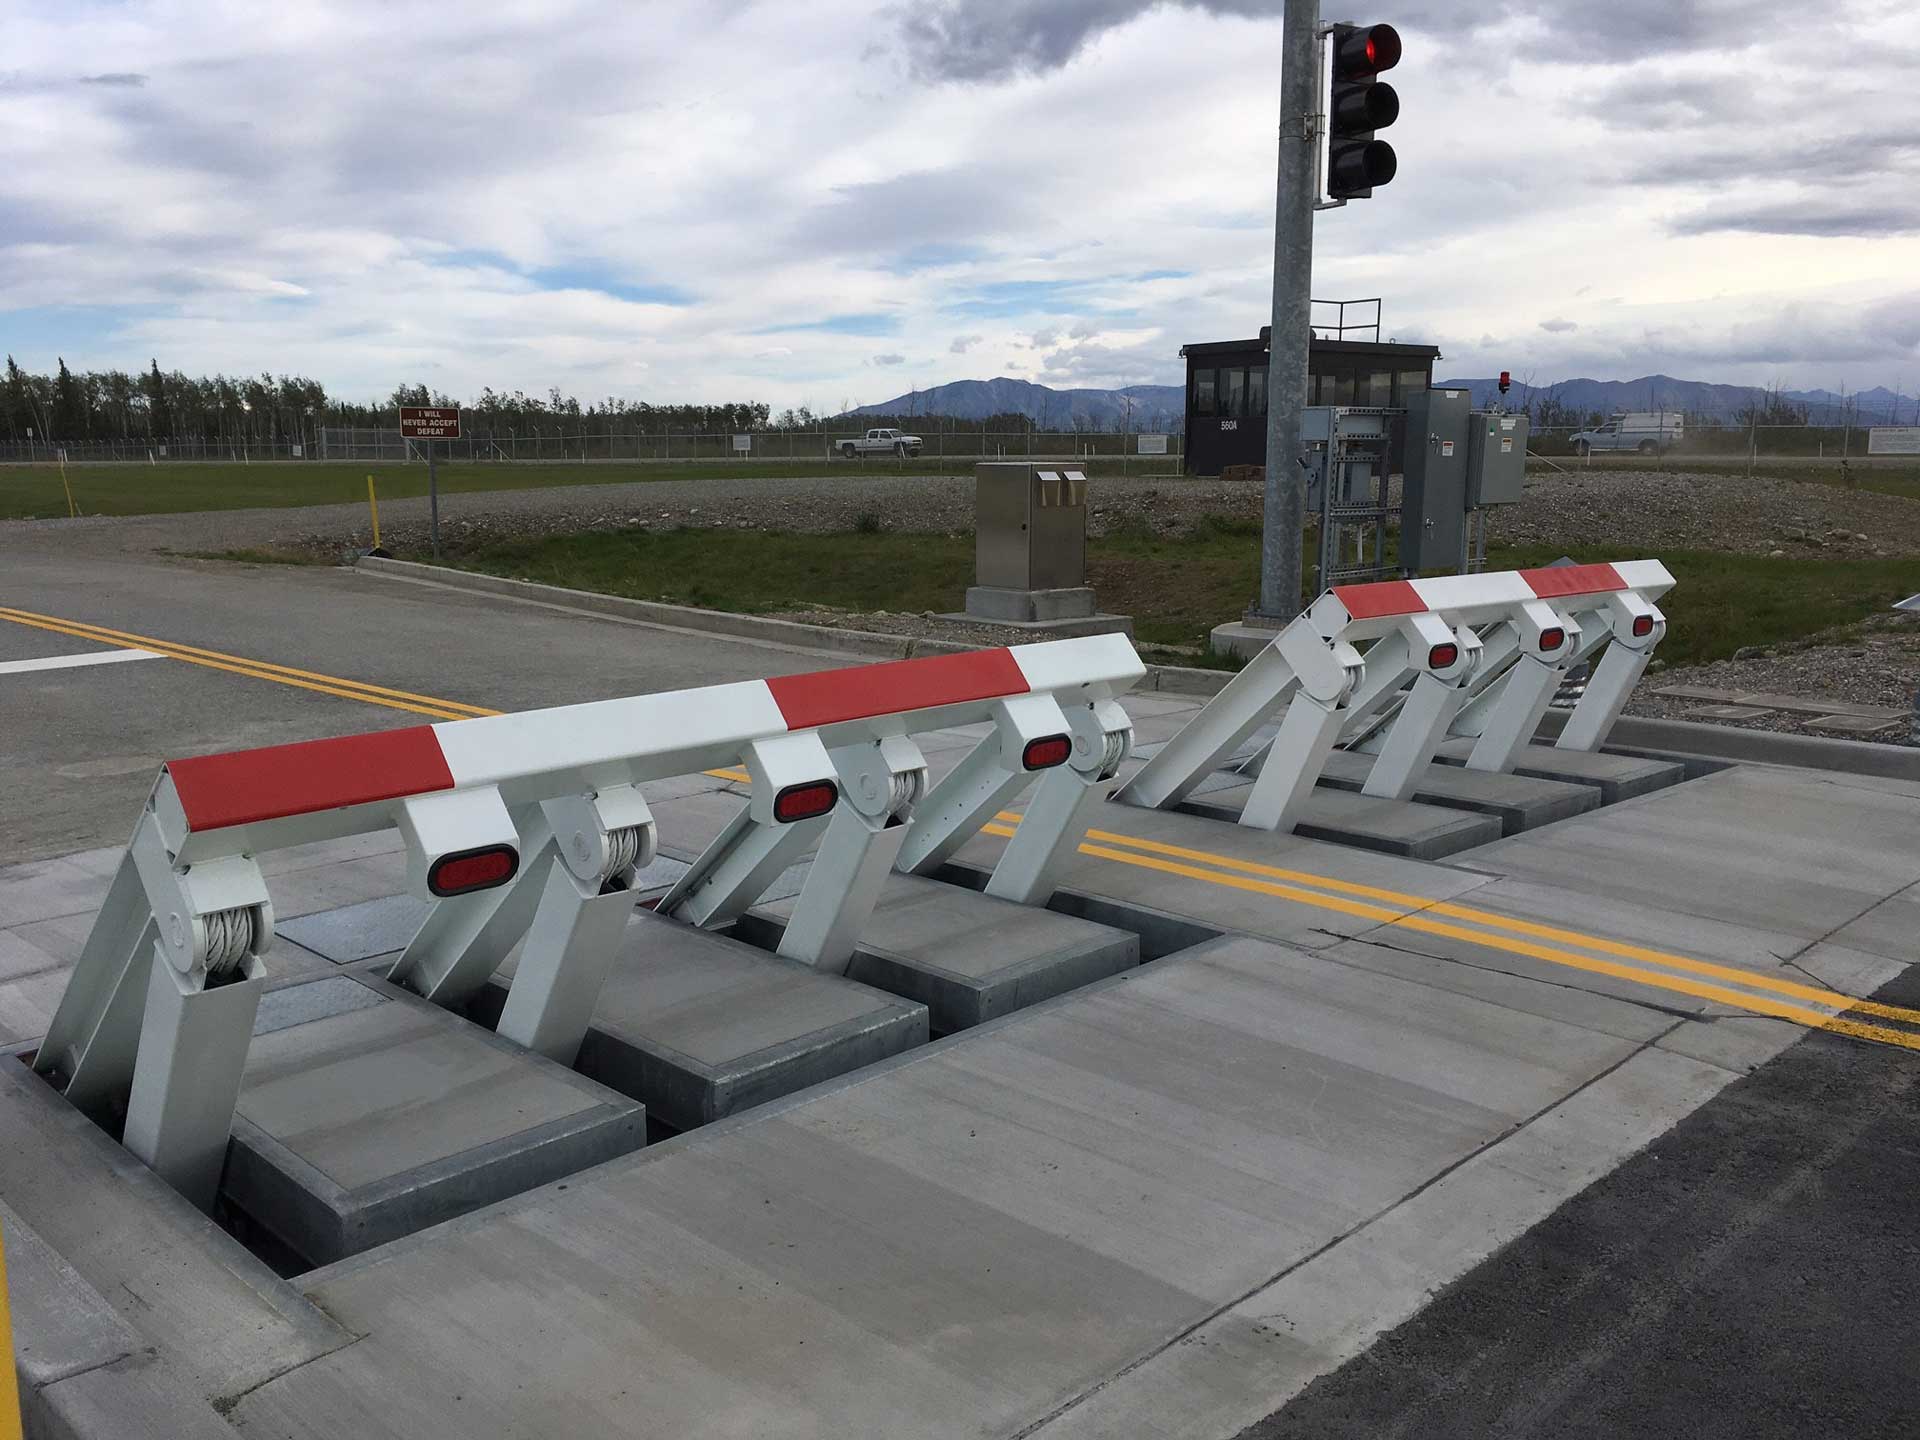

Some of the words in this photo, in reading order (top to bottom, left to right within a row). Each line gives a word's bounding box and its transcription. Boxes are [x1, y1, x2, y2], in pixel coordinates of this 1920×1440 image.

[423, 410, 441, 418] WILL
[429, 419, 458, 427] ACCEPT
[417, 427, 445, 435] DEFEAT
